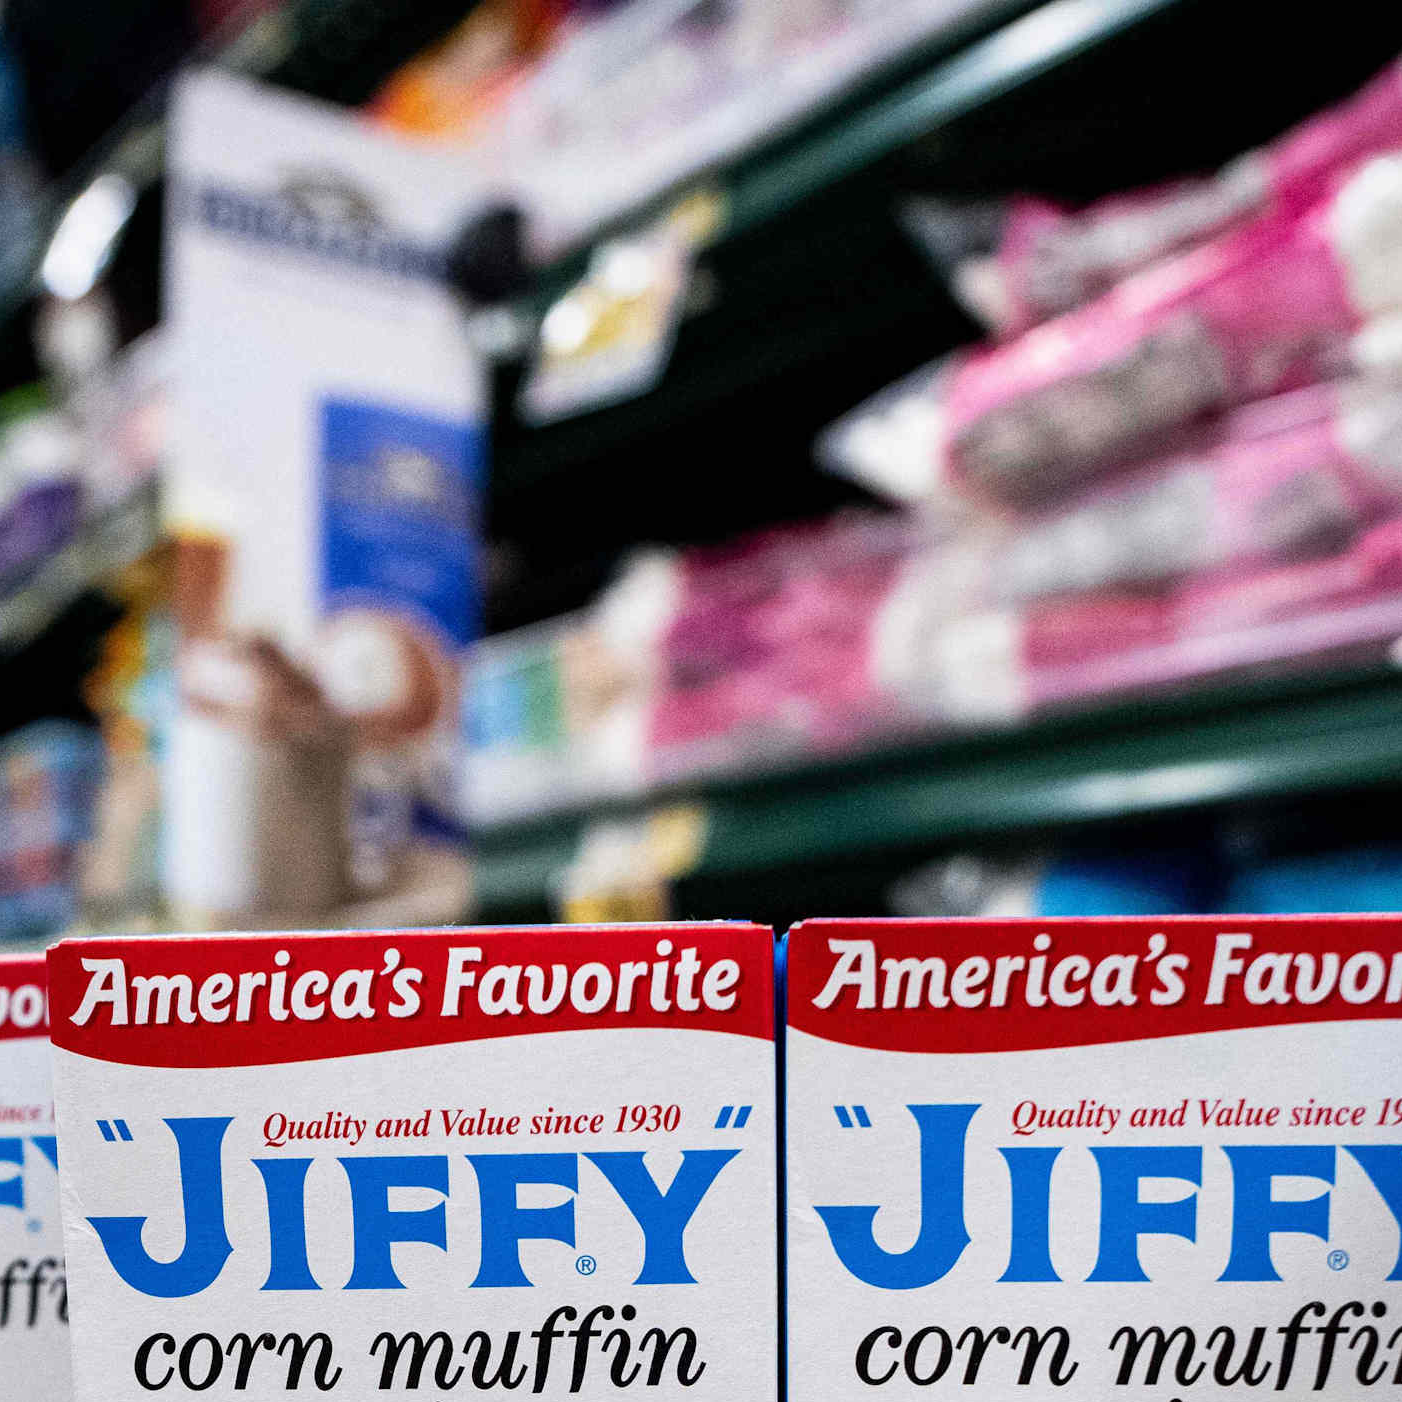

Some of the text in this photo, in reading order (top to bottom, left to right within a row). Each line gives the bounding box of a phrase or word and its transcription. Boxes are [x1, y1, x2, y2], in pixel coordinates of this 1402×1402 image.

[68, 939, 741, 1028] America's Favorite
[811, 932, 1191, 1011] America's
[261, 1104, 682, 1147] Quality and Value since 1930
[1011, 1099, 1123, 1136] Quality
[1129, 1099, 1190, 1128] and
[1197, 1099, 1280, 1129] Value
[1290, 1100, 1368, 1128] since
[133, 1303, 708, 1395] corn muffin
[853, 1324, 1080, 1388] corn
